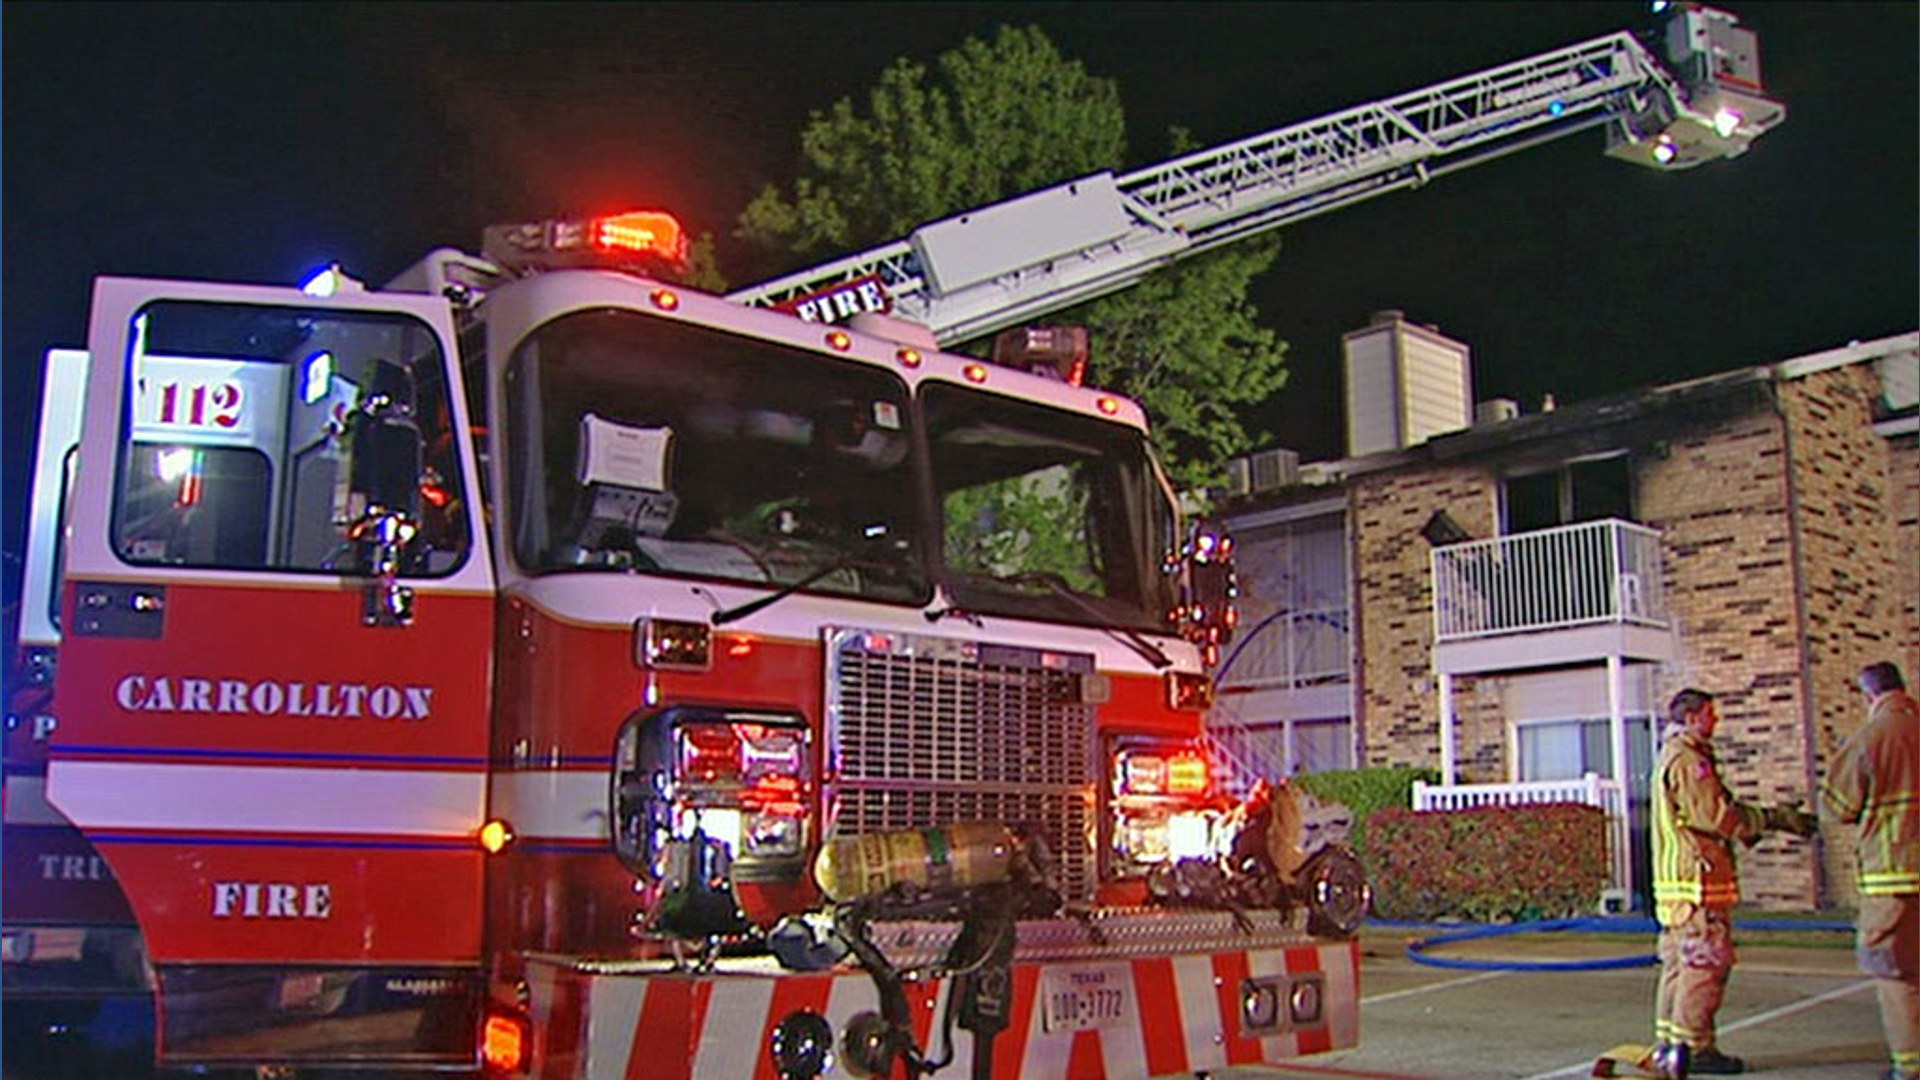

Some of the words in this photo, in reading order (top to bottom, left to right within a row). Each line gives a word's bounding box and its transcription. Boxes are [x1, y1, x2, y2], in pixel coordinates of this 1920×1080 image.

[797, 281, 885, 323] FIRE
[160, 383, 240, 427] 112
[117, 675, 433, 719] CARROLLTON
[212, 882, 331, 918] FIRE
